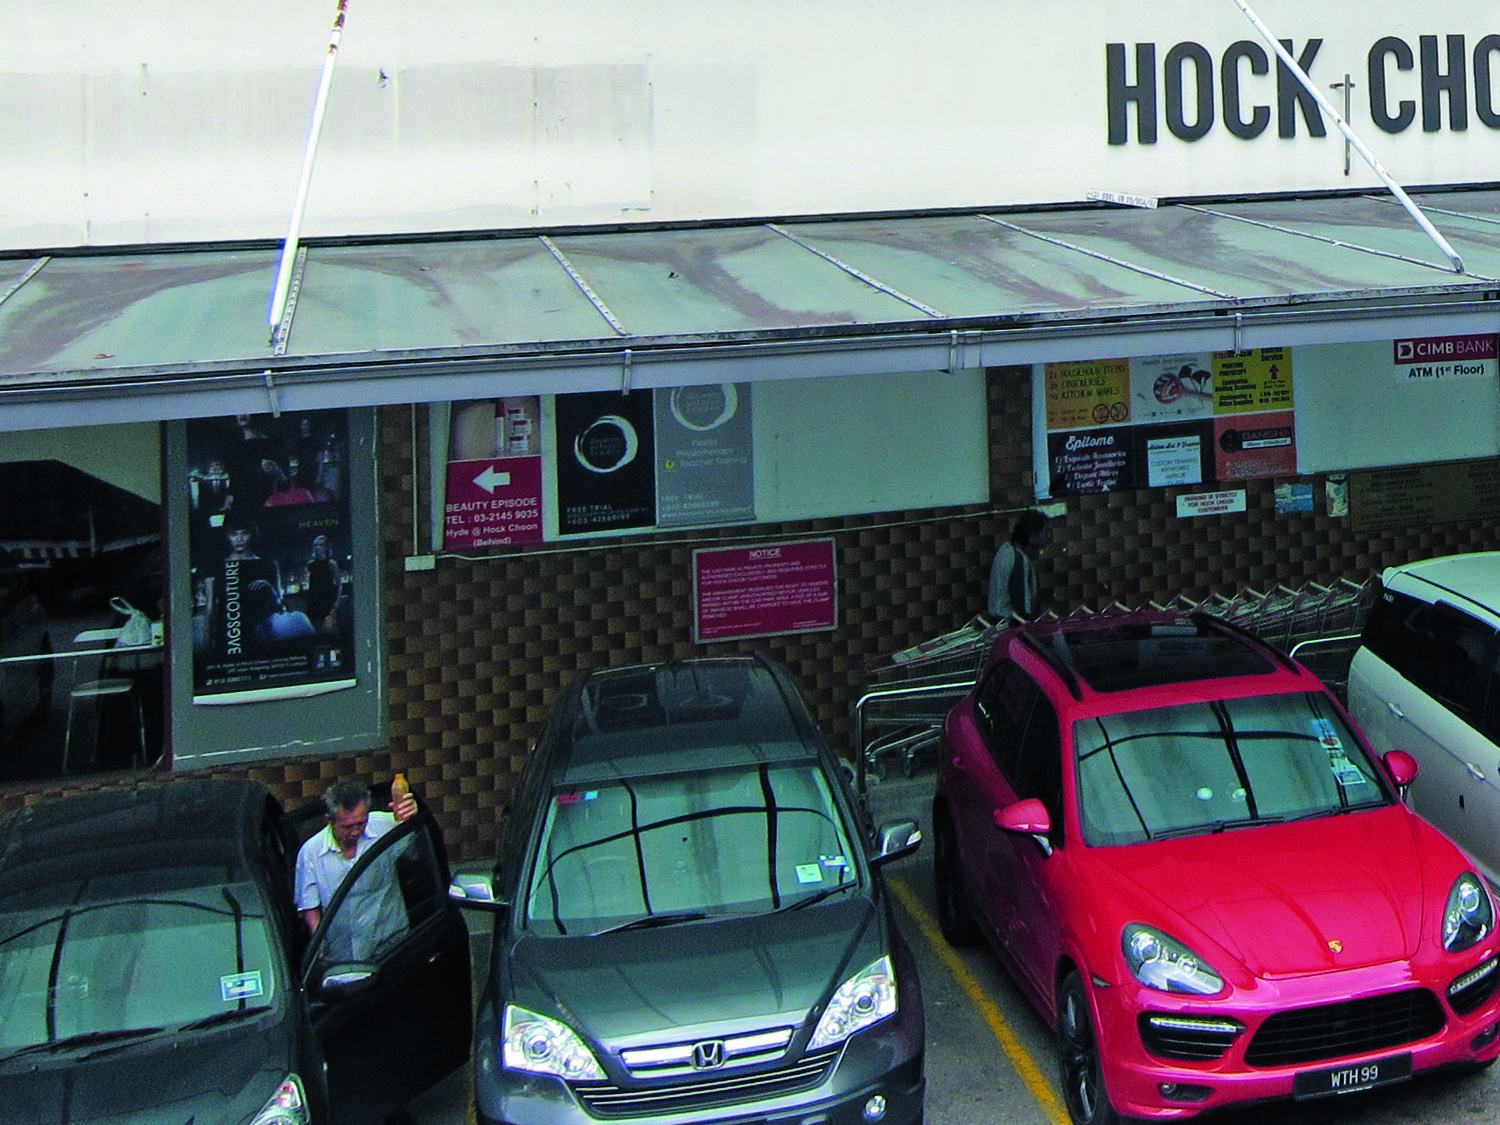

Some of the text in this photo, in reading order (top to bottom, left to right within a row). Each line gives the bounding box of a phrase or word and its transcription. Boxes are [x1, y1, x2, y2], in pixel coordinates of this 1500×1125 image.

[1107, 39, 1327, 145] HOCK
[1417, 338, 1494, 355] CIMB BANK
[1409, 366, 1433, 378] ATM
[1454, 363, 1484, 376] Floor)
[1066, 435, 1115, 451] Epitome
[446, 497, 538, 513] BEAUTY EPISODE
[446, 515, 465, 525] TEL
[473, 511, 513, 523] 03-2145
[515, 509, 539, 519] 9035
[446, 529, 469, 538] Hyde
[483, 525, 506, 534] Hock
[508, 523, 538, 532] Choon
[749, 548, 781, 559] NOTICE
[1331, 1065, 1378, 1087] WTH 99
